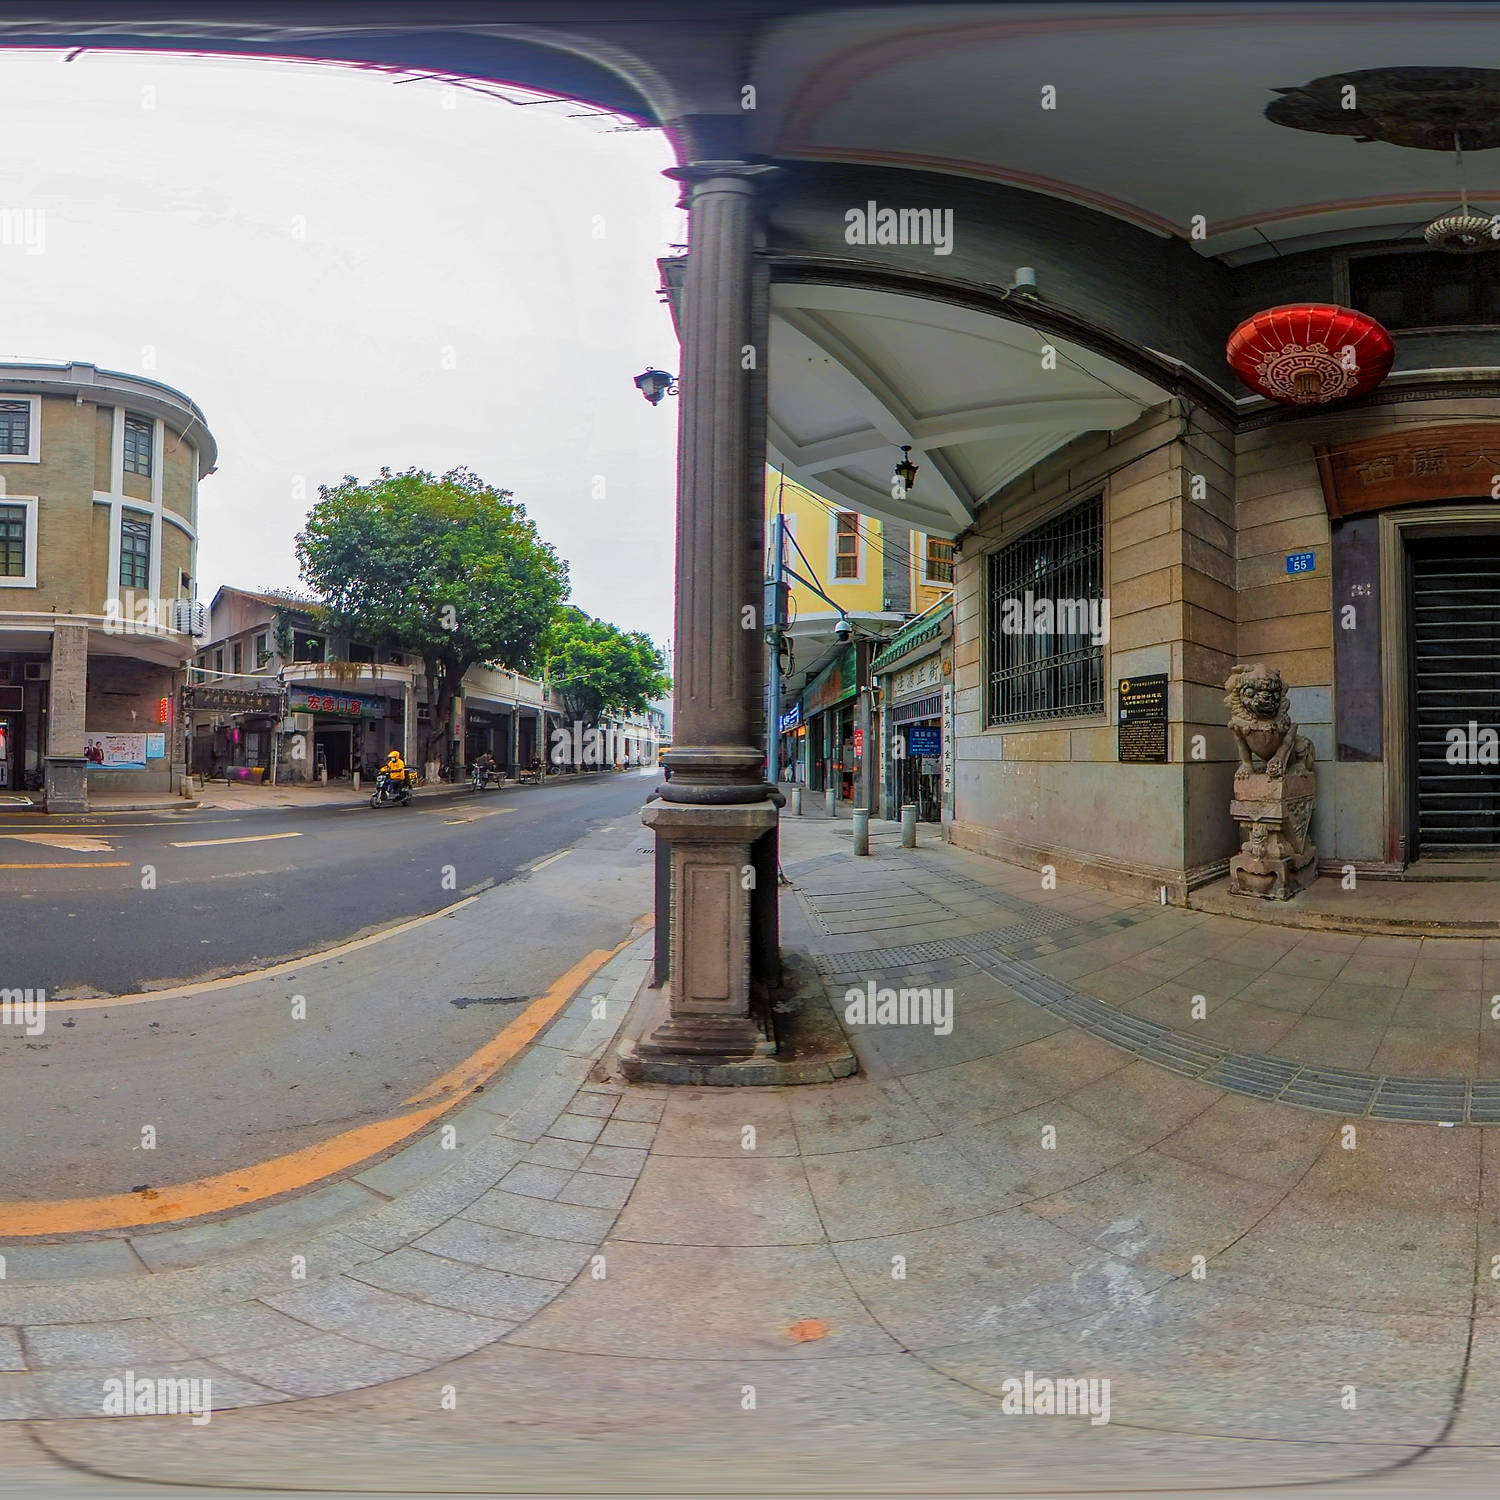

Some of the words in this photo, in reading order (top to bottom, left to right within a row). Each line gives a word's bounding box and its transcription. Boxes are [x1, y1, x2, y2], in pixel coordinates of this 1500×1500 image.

[1294, 560, 1306, 570] 55
[307, 694, 363, 716] 宏德门窗
